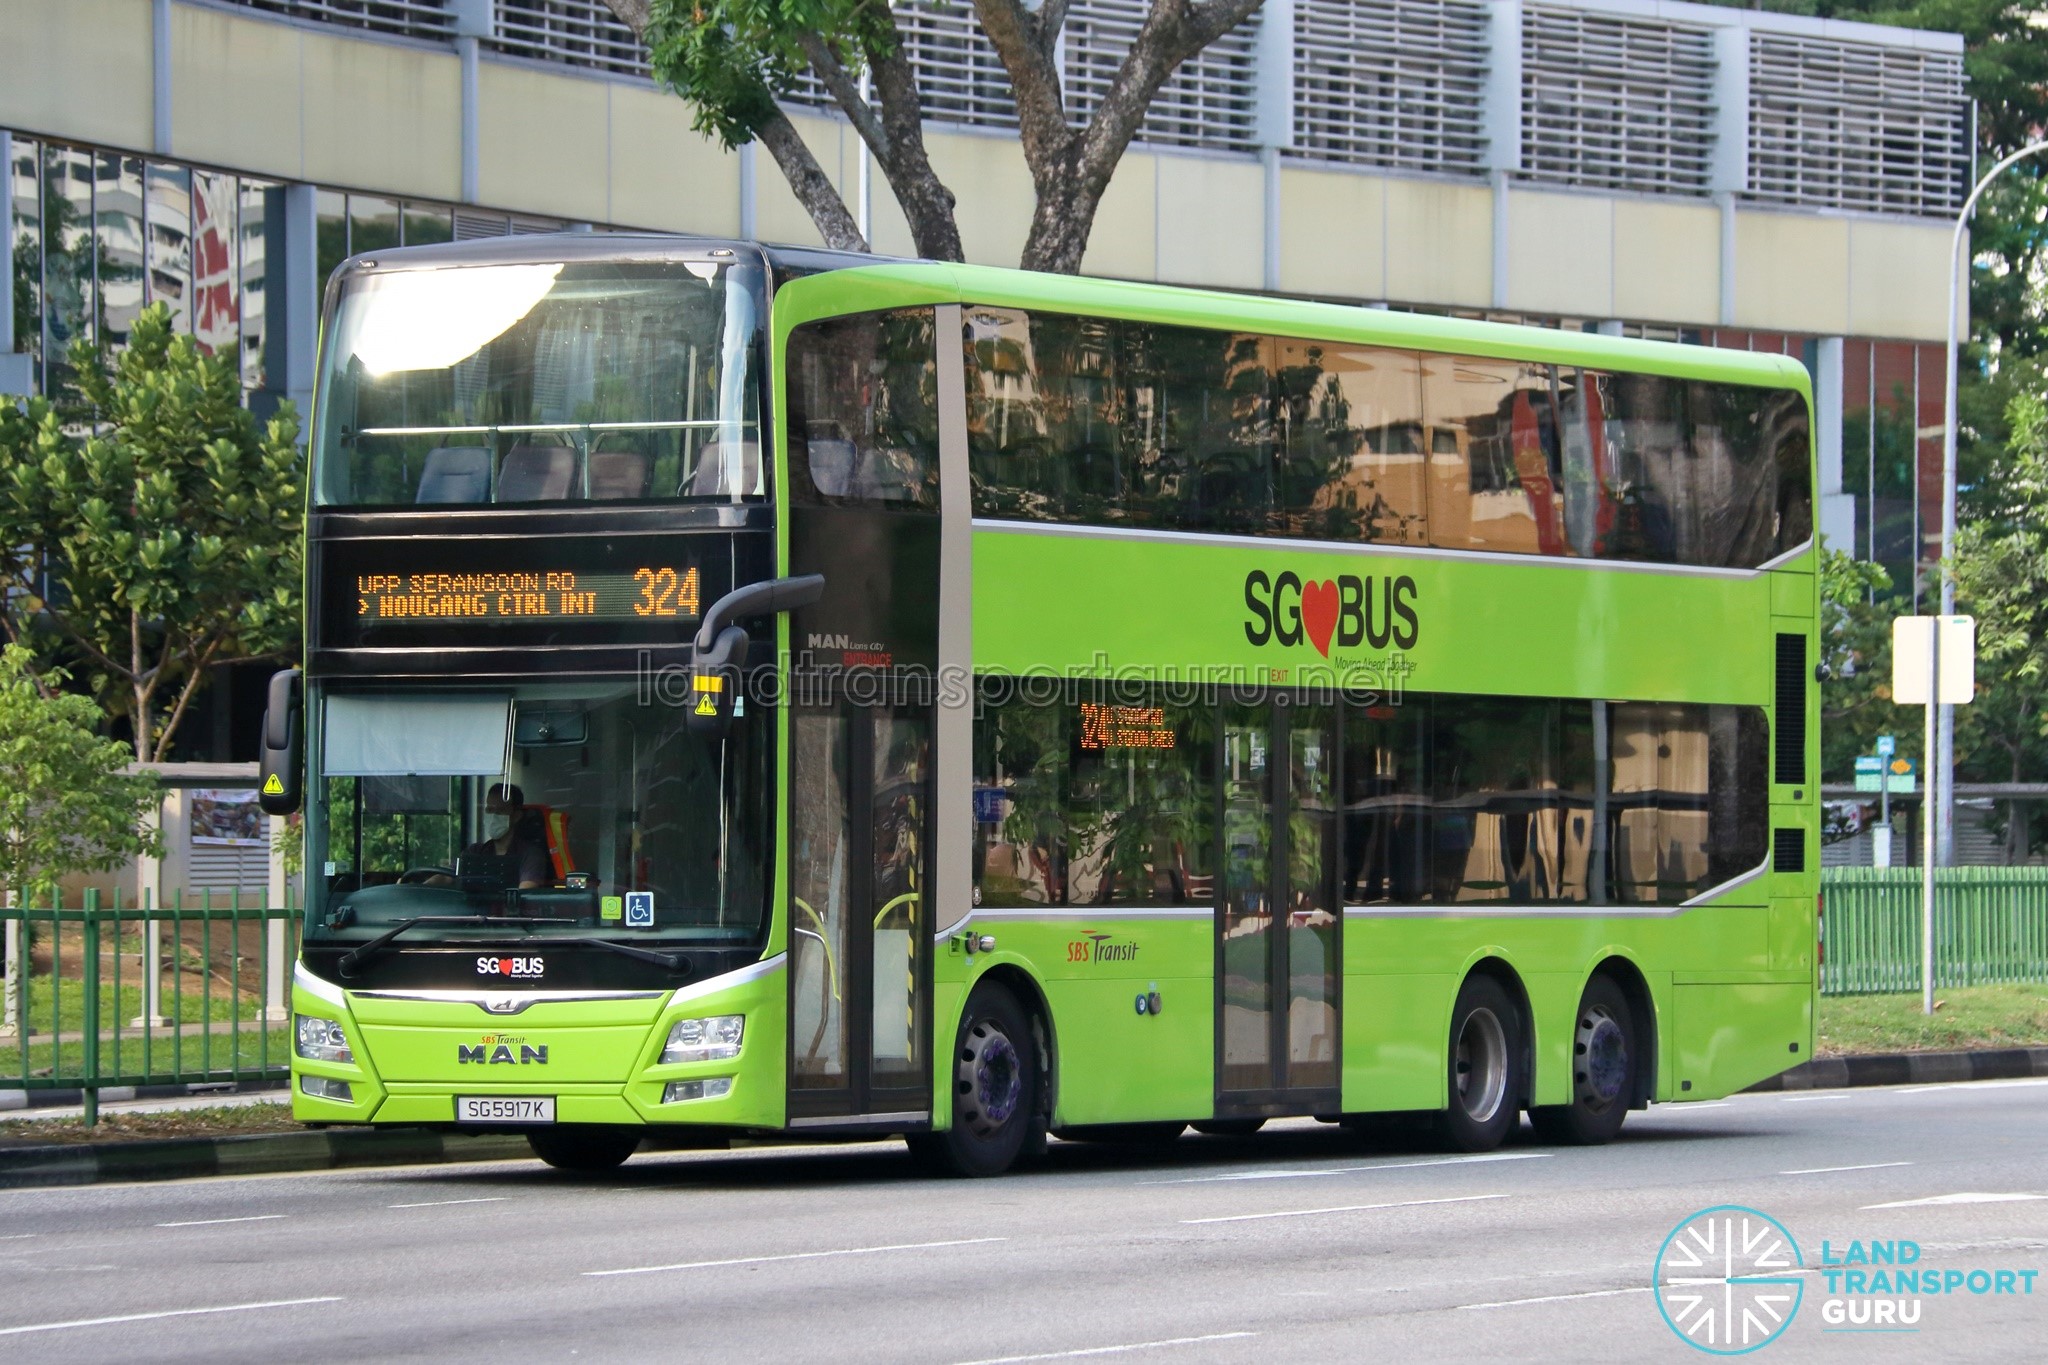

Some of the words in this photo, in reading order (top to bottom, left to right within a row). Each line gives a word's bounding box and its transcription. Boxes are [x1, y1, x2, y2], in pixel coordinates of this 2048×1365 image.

[358, 575, 401, 594] UPP
[409, 573, 539, 593] SERANGOON
[546, 572, 575, 591] RD
[633, 567, 699, 616] 324
[379, 594, 488, 617] HOUGANG
[497, 593, 550, 616] CTRL
[560, 592, 597, 614] INT
[808, 633, 848, 649] MAN
[869, 642, 884, 651] City
[843, 652, 892, 668] ENTRANCE
[1334, 656, 1361, 673] Moving
[1363, 658, 1386, 671] Ahead
[1271, 669, 1289, 682] EXIT
[1067, 942, 1089, 962] SBS
[1088, 935, 1140, 965] Transit
[481, 1036, 496, 1044] SBS
[494, 1034, 526, 1045] Transit
[458, 1044, 548, 1065] MAN
[468, 1101, 545, 1118] SG5917K
